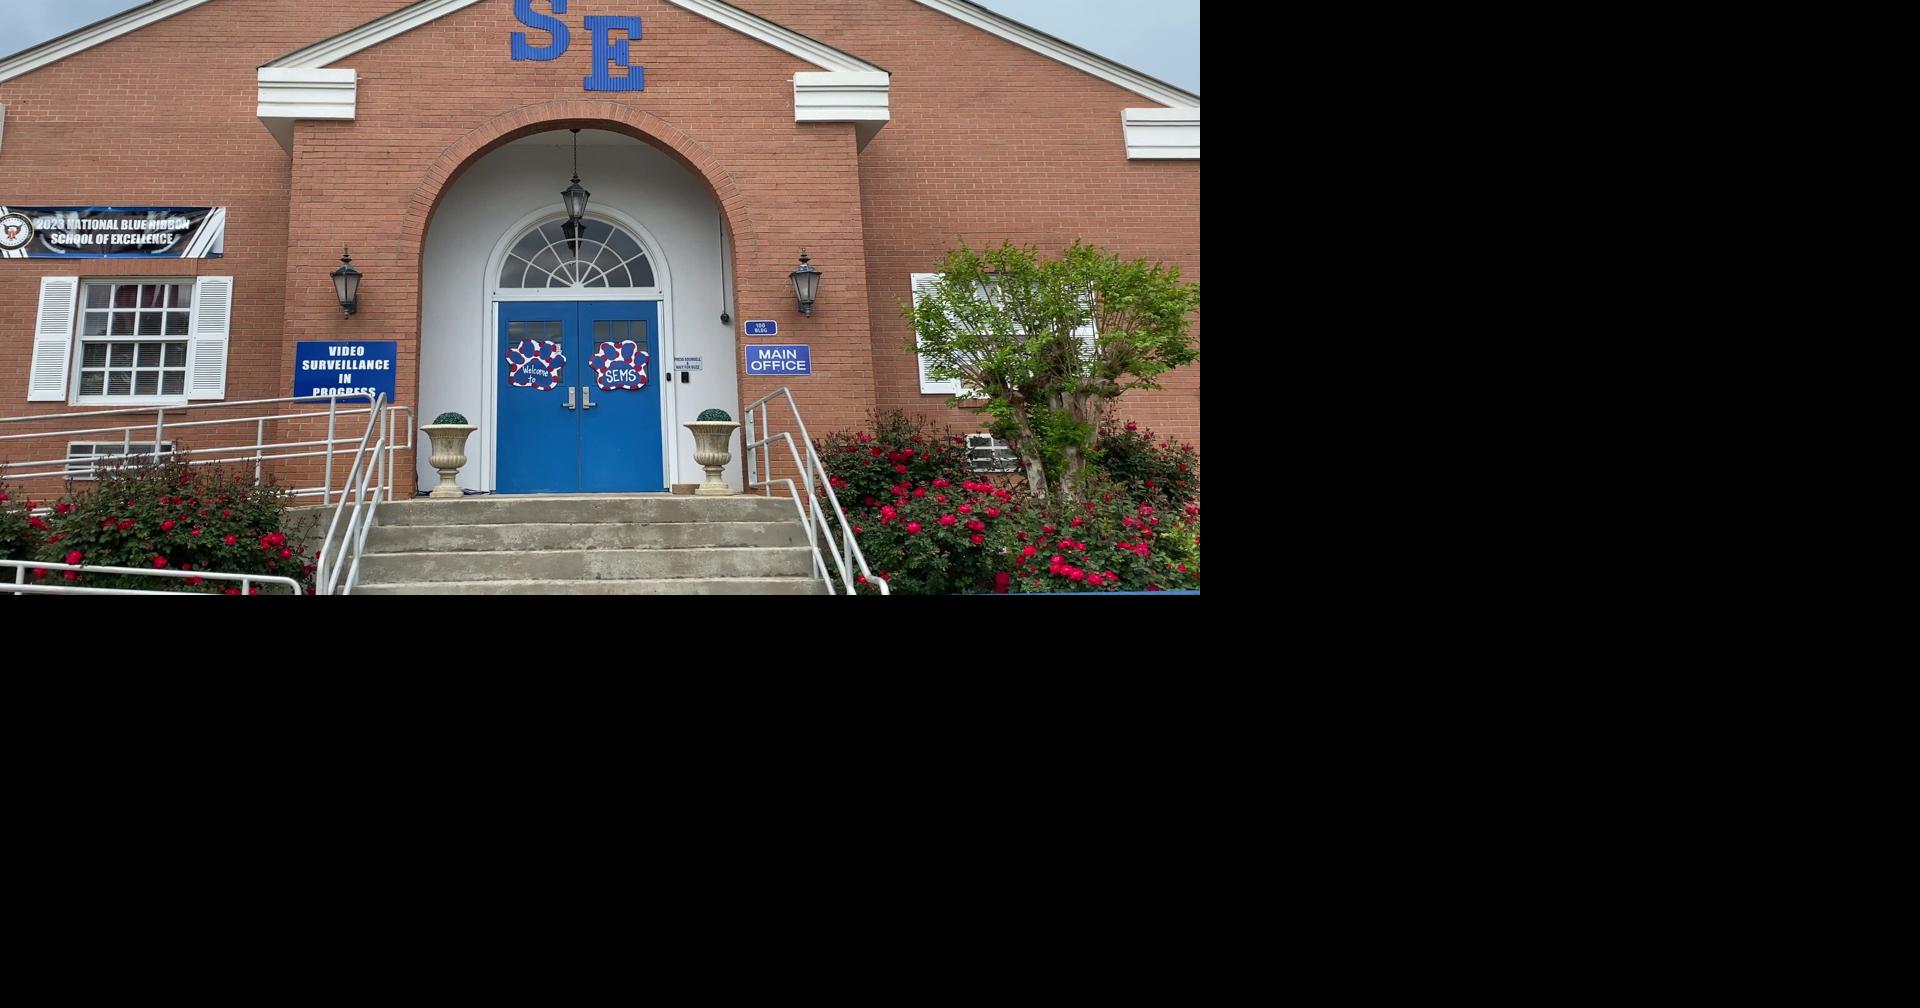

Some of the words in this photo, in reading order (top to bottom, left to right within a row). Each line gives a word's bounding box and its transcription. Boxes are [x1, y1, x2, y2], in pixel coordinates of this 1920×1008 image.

[511, 0, 570, 61] S
[584, 15, 644, 91] E
[36, 218, 65, 230] 2023
[67, 218, 119, 230] NATIONAL
[121, 219, 147, 230] BLUE
[148, 219, 190, 230] RIBBON
[51, 233, 94, 245] SCHOOL
[95, 233, 110, 245] OF
[110, 233, 173, 245] EXCELLENCE
[328, 346, 365, 356] VIDEO
[758, 349, 797, 359] MAIN
[302, 359, 390, 370] SURVEILLANCE
[750, 360, 807, 371] OFFICE
[522, 365, 549, 377] Welcome
[605, 368, 637, 383] SEMS
[338, 373, 352, 384] IN
[528, 375, 537, 383] to
[312, 387, 376, 397] PROGRESS
